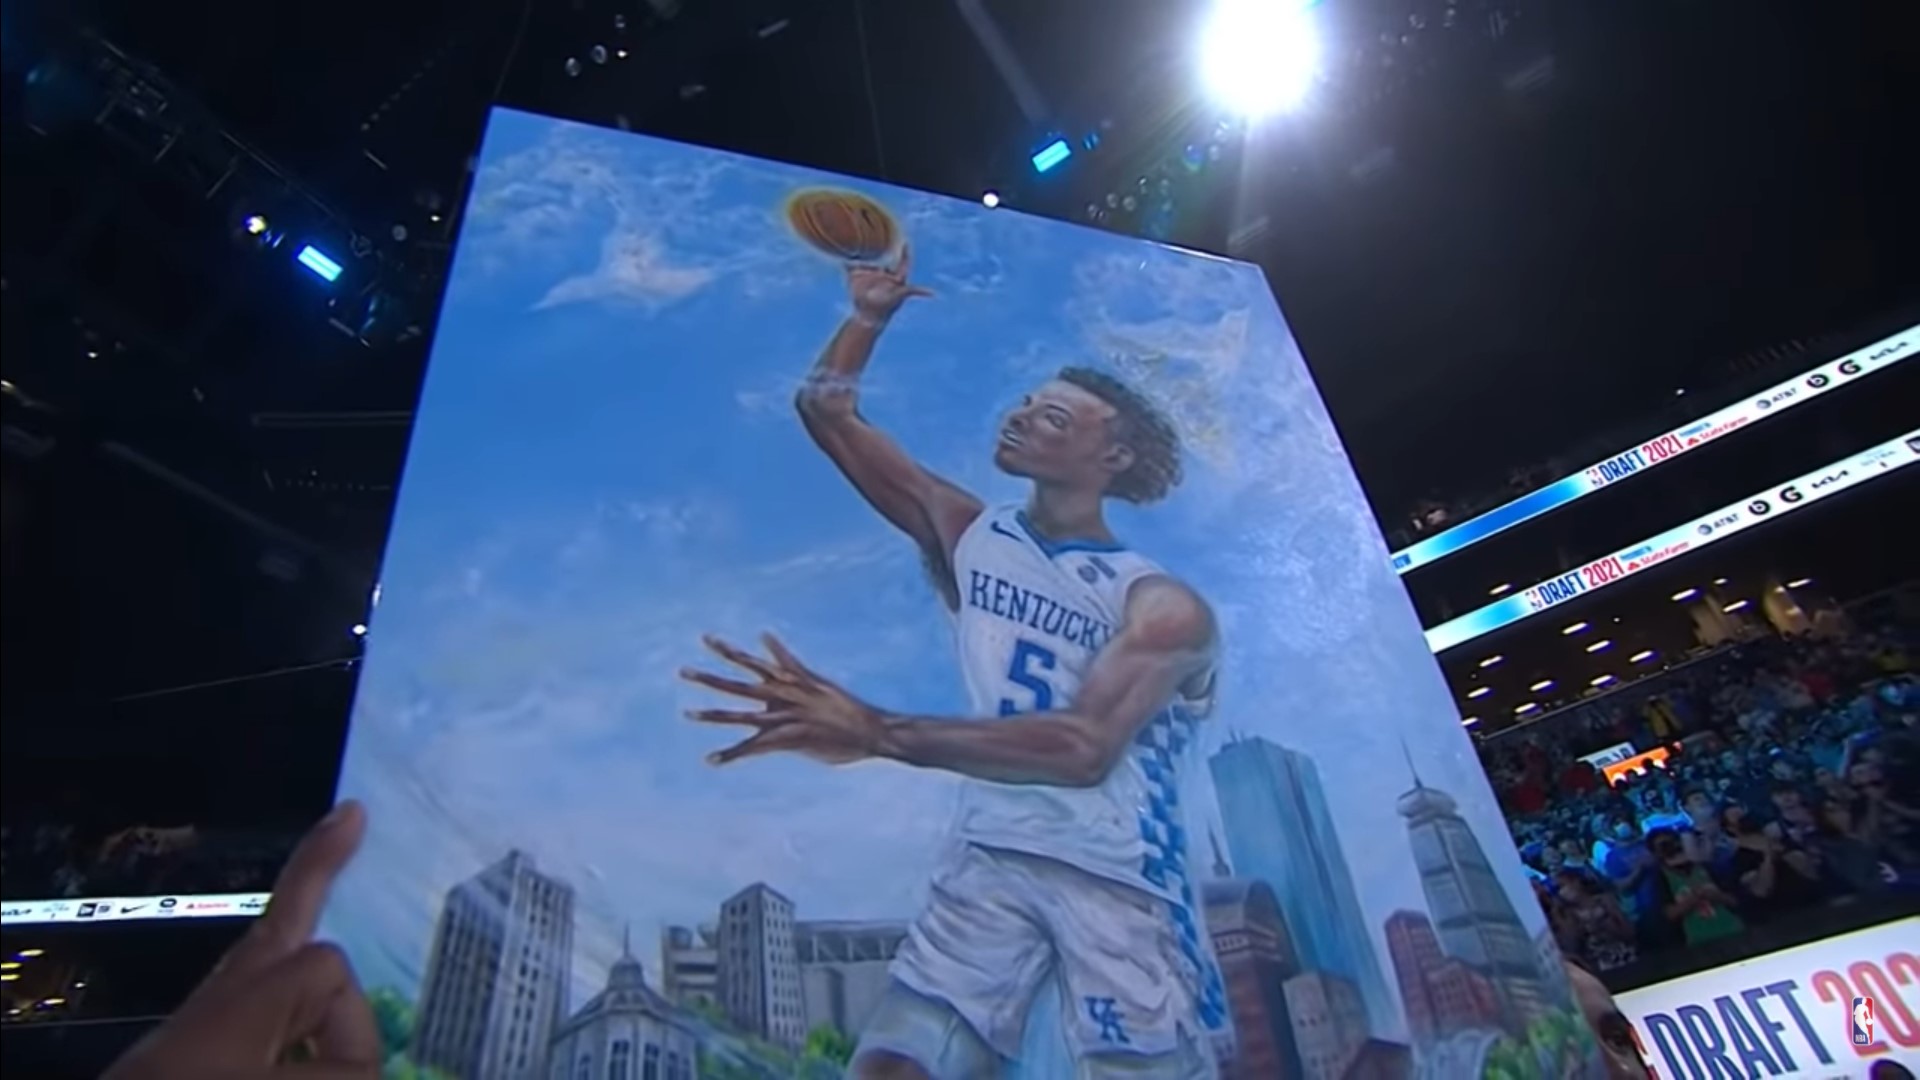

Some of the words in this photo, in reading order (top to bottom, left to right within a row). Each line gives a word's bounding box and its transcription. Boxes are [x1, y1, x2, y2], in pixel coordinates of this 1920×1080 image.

[1772, 387, 1798, 403] AT&T
[1599, 449, 1646, 483] DRAFT
[1641, 433, 1684, 463] 2021
[1714, 512, 1740, 530] AT&T
[1538, 571, 1587, 605] DRAFT
[1582, 556, 1625, 587] 2021
[998, 638, 1057, 718] 5
[1643, 978, 1836, 1080] DRAFT
